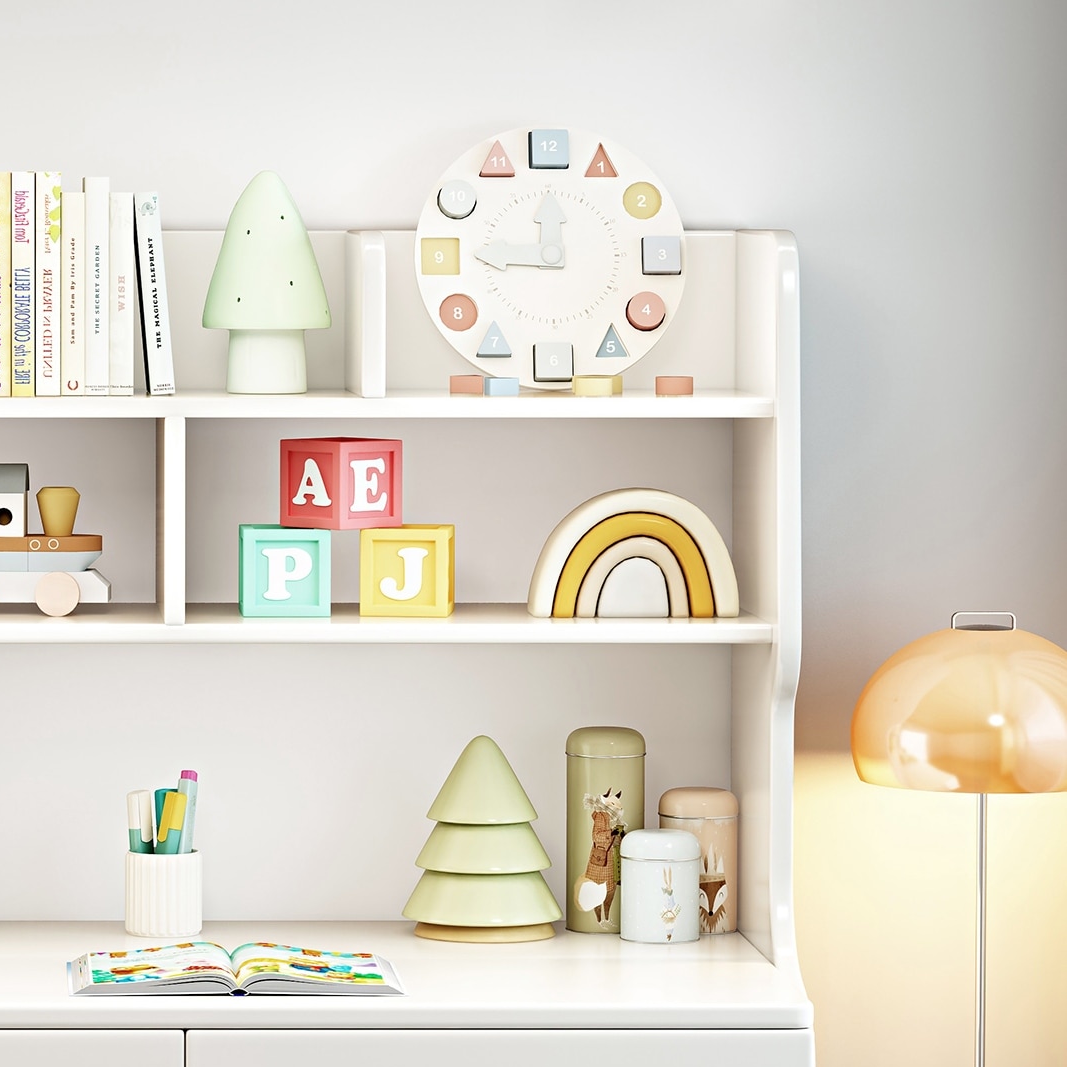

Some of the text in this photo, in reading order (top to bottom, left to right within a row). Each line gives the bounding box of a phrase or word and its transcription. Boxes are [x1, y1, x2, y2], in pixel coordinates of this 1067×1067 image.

[540, 140, 558, 152] 12
[490, 156, 507, 168] 11
[597, 161, 605, 173] 1
[450, 190, 466, 202] 10
[637, 195, 647, 208] 2
[147, 237, 157, 283] ELEPHANT
[434, 251, 444, 264] 9
[658, 248, 668, 260] 3
[153, 288, 161, 327] MAGICAL
[453, 307, 464, 320] 8
[641, 304, 652, 316] 4
[490, 337, 499, 348] 7
[606, 341, 616, 353] 5
[549, 354, 558, 367] 6
[292, 458, 332, 507] A
[350, 457, 388, 513] E
[261, 547, 313, 601] P
[379, 547, 429, 601] J
